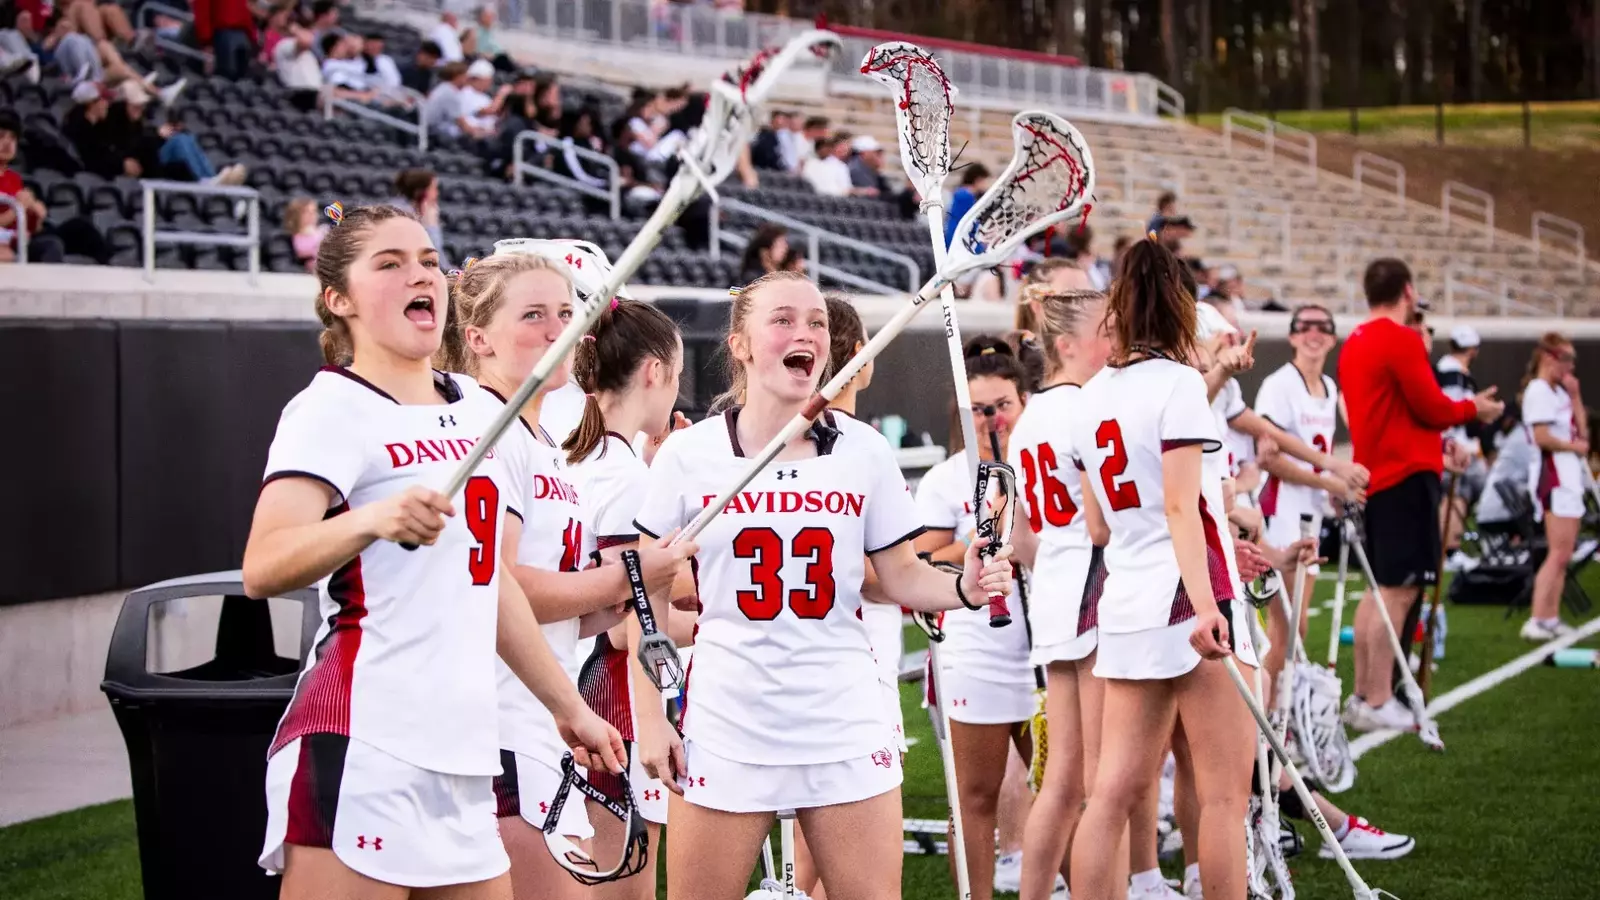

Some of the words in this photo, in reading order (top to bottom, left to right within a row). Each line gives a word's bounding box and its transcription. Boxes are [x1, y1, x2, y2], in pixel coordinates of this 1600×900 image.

[565, 253, 582, 269] 44
[942, 304, 954, 338] GAIT
[384, 437, 499, 468] DAVID
[1094, 418, 1141, 512] 2
[1020, 441, 1078, 534] 36
[464, 475, 499, 586] 9
[732, 526, 835, 621] 33
[634, 586, 648, 610] GAIT
[581, 784, 607, 803] GAIT
[1310, 808, 1327, 829] GAIT
[785, 863, 794, 896] GAIT
